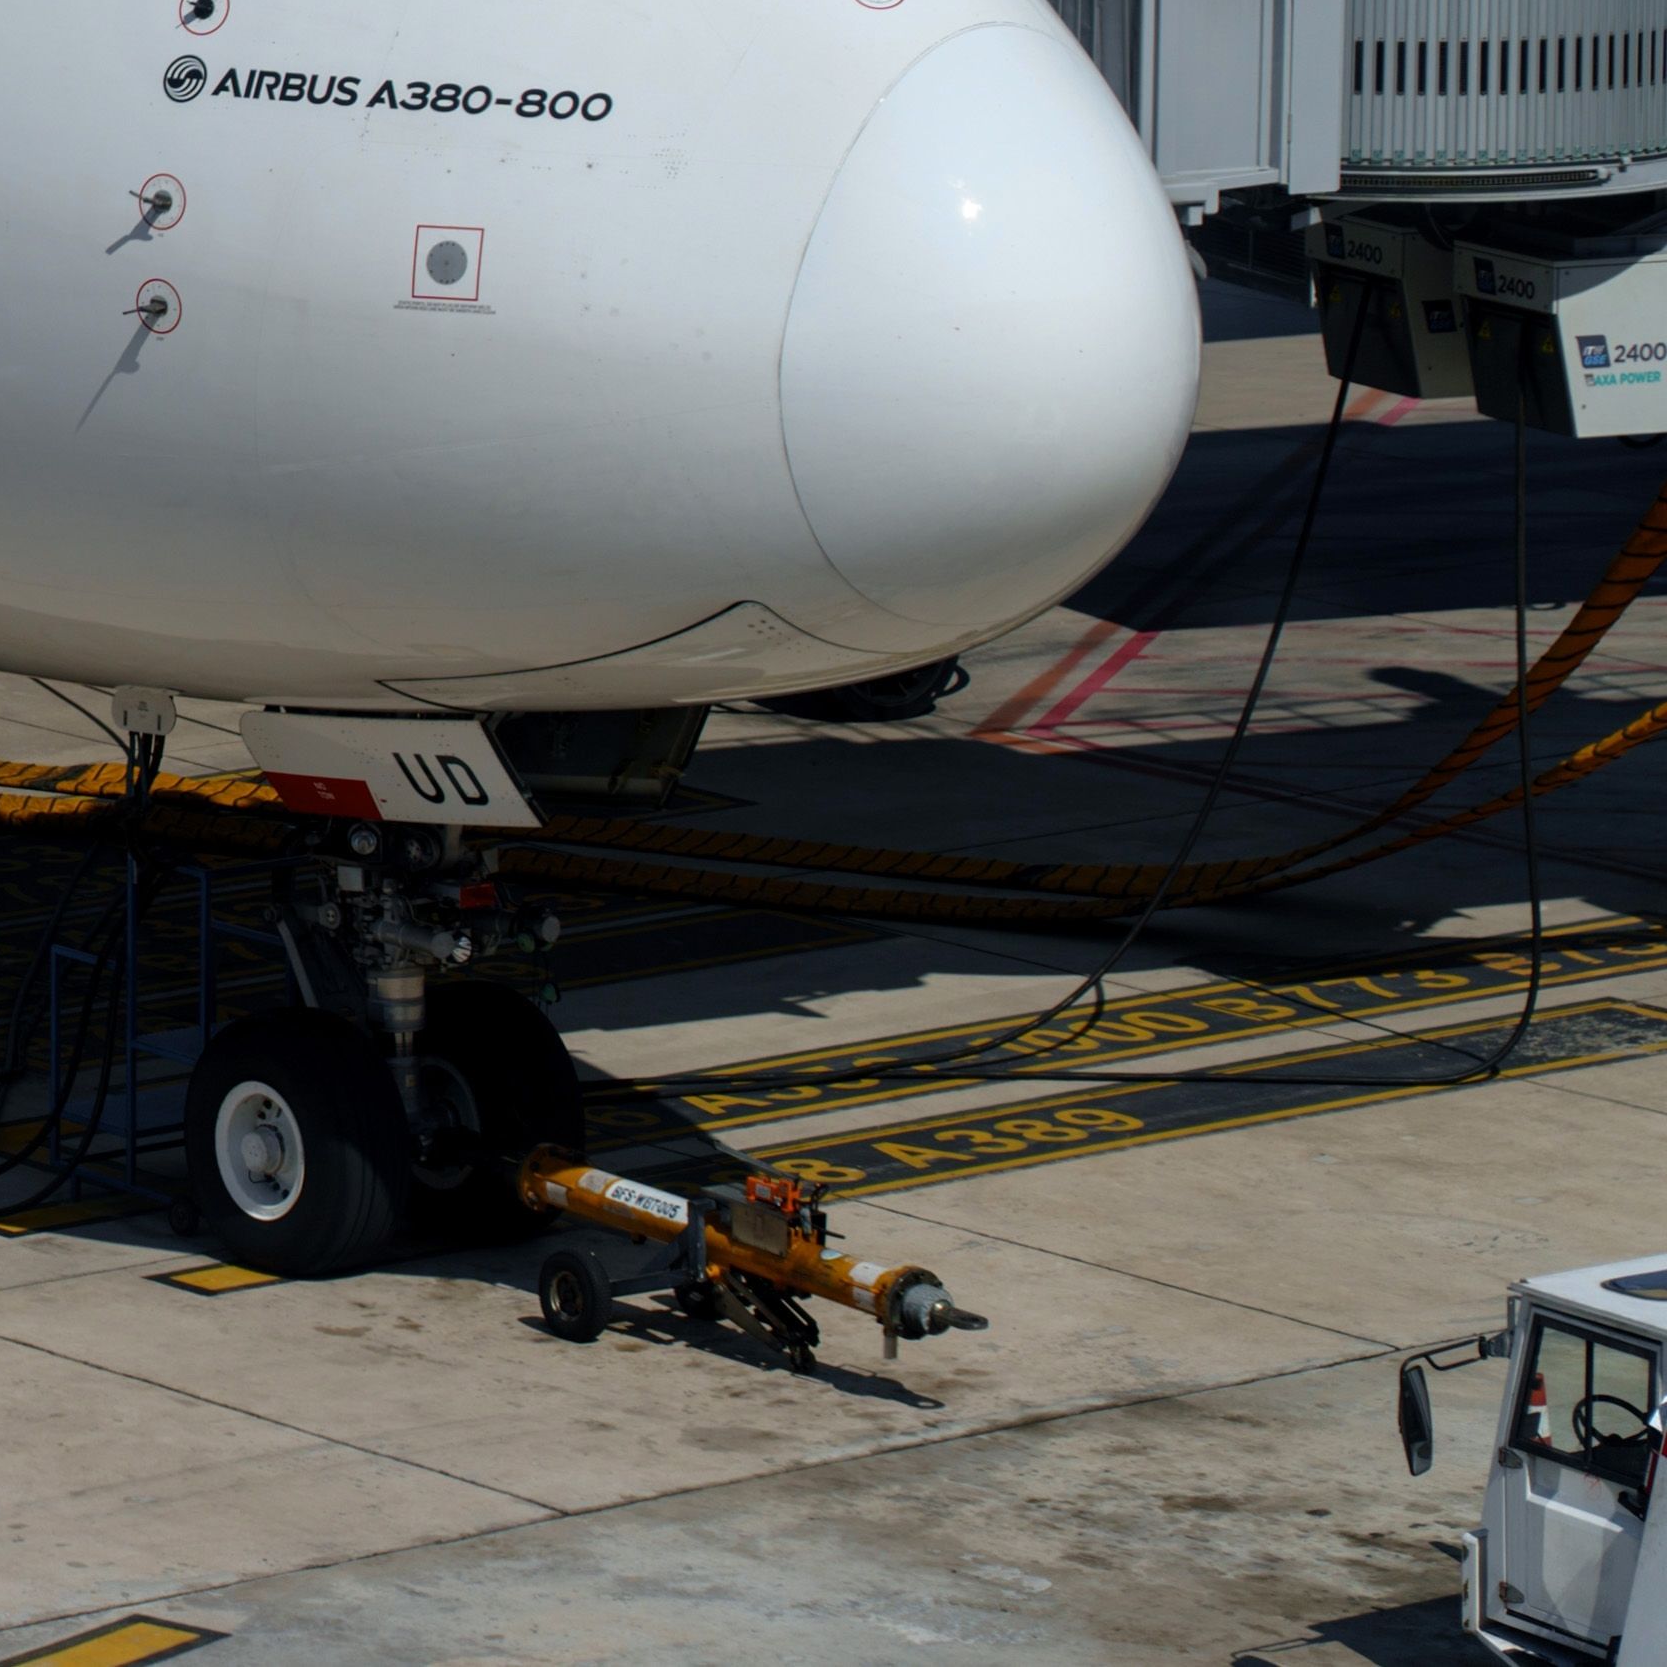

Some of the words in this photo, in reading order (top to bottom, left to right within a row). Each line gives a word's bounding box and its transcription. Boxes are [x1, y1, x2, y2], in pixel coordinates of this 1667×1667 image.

[211, 67, 360, 107] AIRBUS
[366, 79, 613, 122] A380-800
[1347, 240, 1383, 265] 2400
[1498, 275, 1535, 299] 2400
[1614, 342, 1667, 363] 2400
[1620, 371, 1660, 384] POWER
[392, 752, 489, 806] UD
[872, 1108, 1145, 1168] A389
